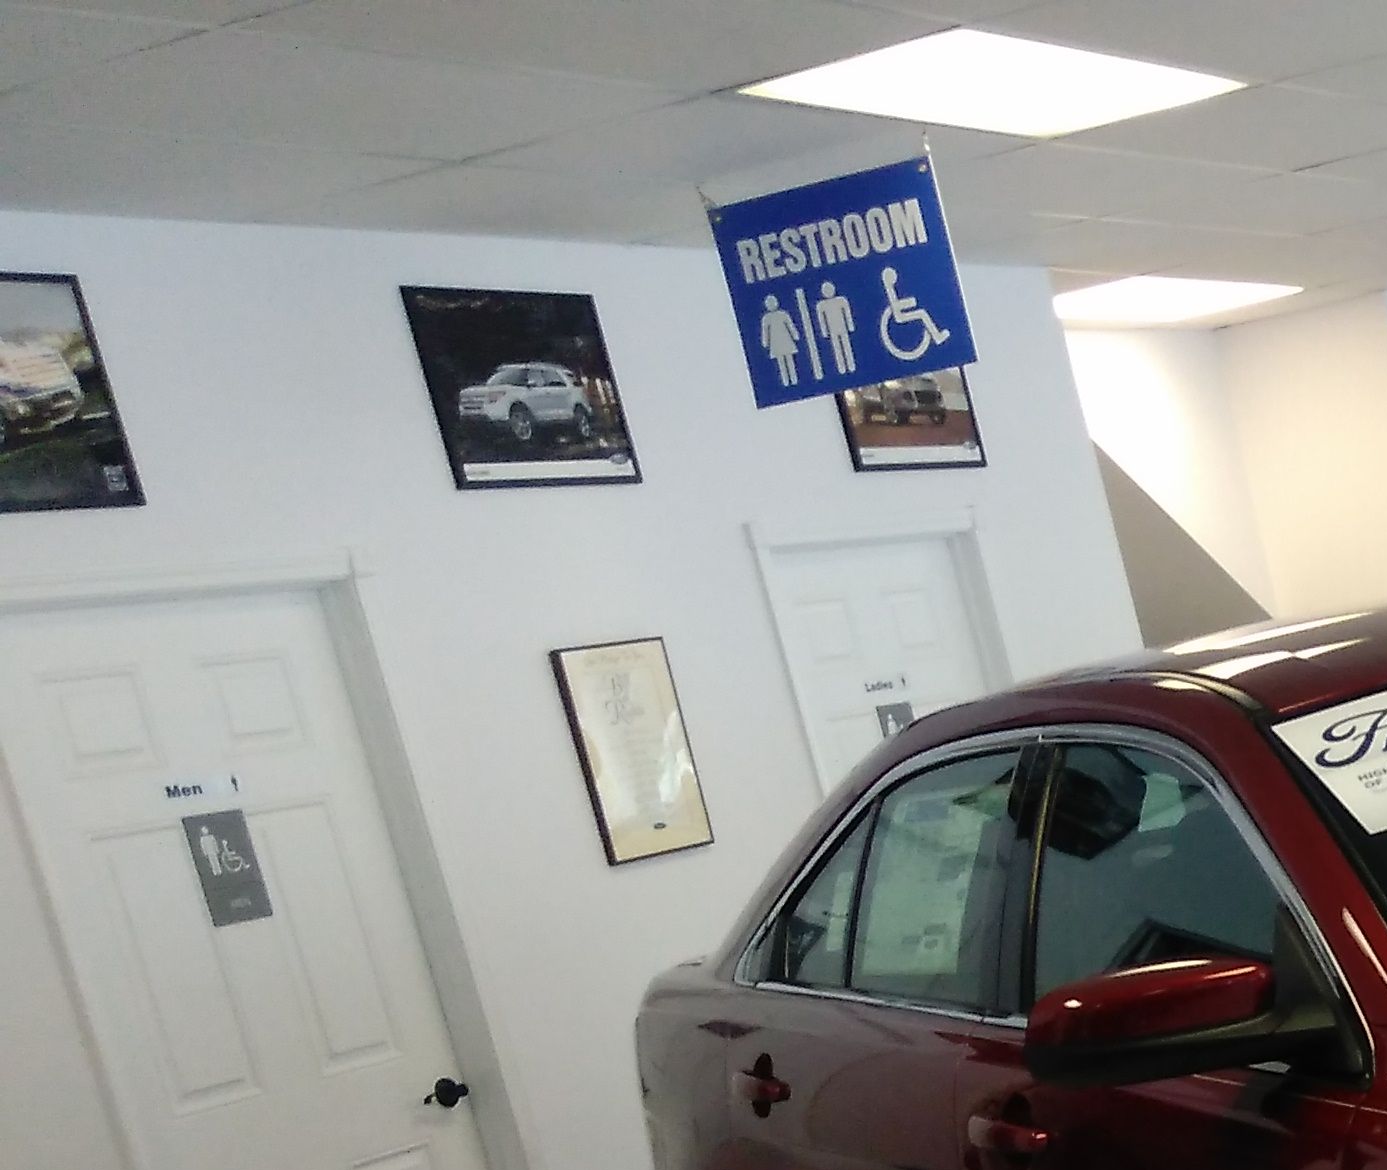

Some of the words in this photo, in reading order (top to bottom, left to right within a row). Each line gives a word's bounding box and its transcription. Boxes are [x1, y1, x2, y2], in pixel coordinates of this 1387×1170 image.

[736, 198, 928, 284] RESTROOM
[1364, 778, 1382, 789] OF
[165, 785, 203, 799] Men
